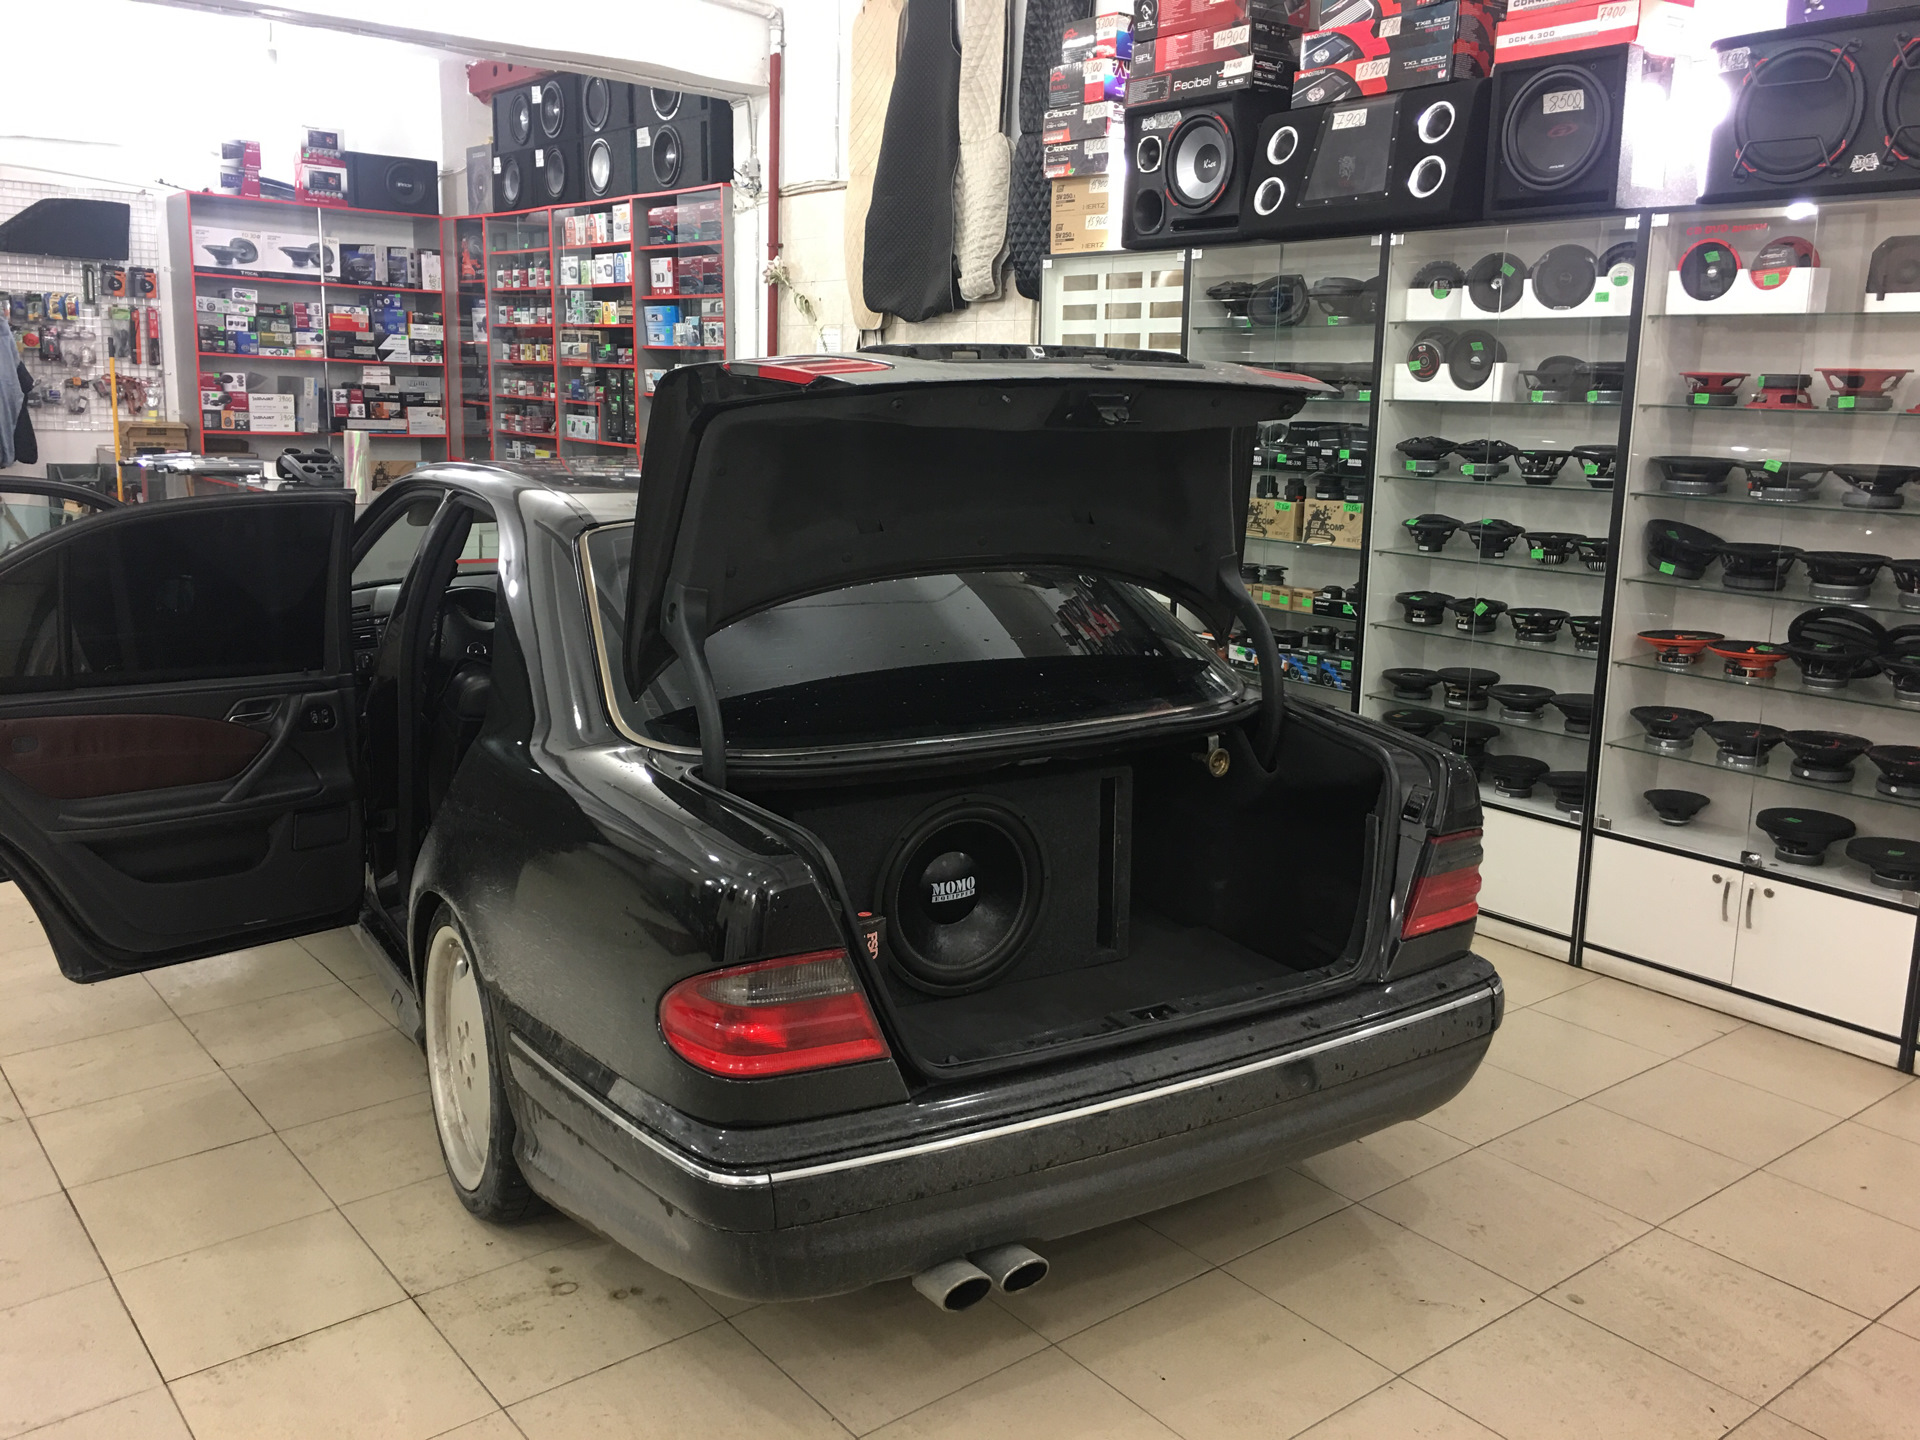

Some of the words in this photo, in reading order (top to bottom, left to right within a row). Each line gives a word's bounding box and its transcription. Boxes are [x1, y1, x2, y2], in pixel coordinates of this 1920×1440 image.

[1137, 20, 1155, 29] SPL
[1215, 28, 1246, 48] 14900
[1549, 92, 1582, 112] 8500
[1686, 226, 1702, 236] CD
[1704, 224, 1729, 234] DVD
[1325, 523, 1345, 531] COMP
[931, 876, 976, 896] MOMO
